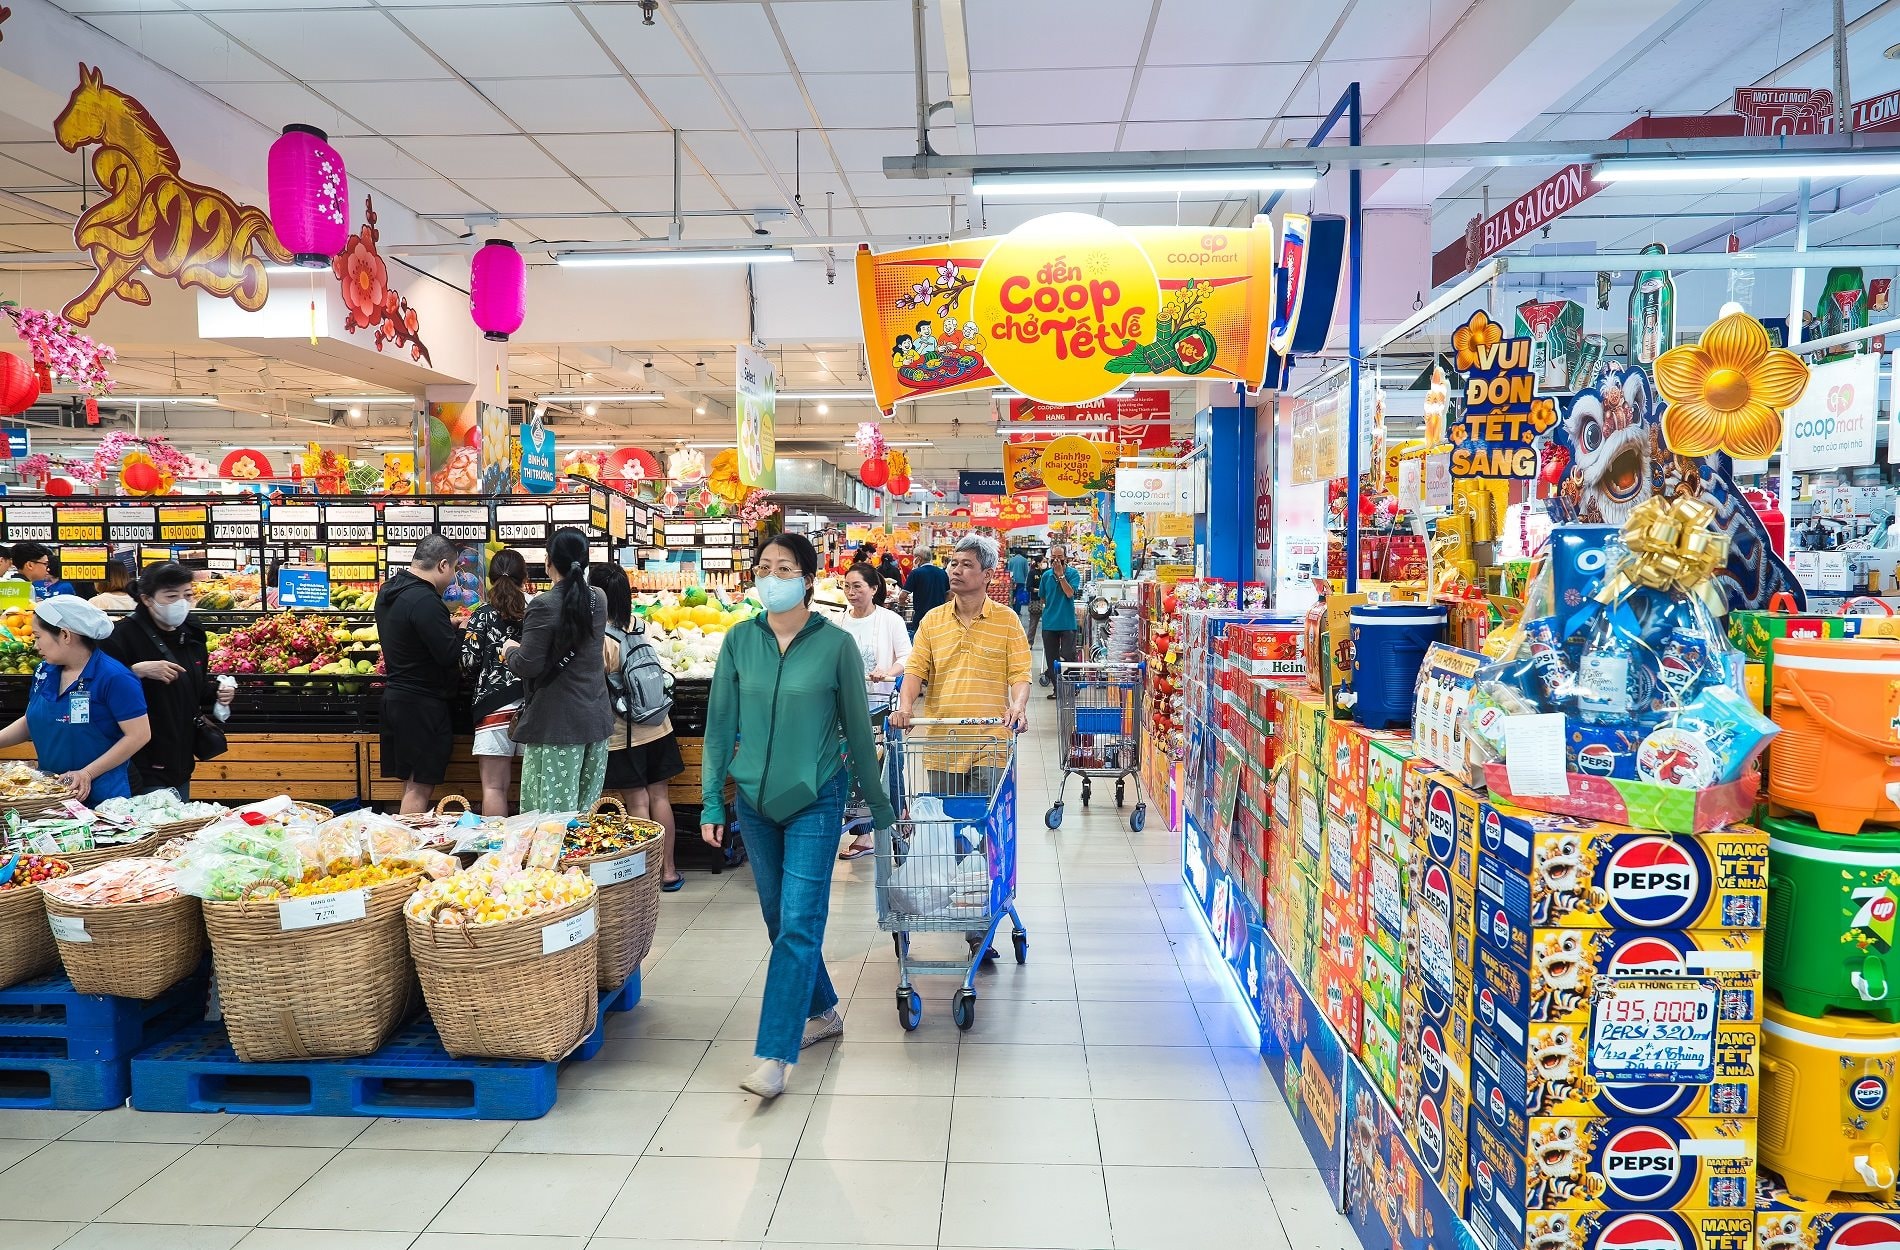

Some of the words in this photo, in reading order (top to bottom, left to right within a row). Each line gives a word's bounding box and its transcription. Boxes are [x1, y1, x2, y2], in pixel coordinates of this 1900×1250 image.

[1483, 210, 1513, 255] BIA
[1514, 167, 1582, 236] SAIGON
[77, 146, 269, 312] 2026
[1037, 255, 1082, 285] đến
[991, 313, 1040, 344] chở
[1040, 315, 1138, 361] Tết
[1180, 341, 1201, 360] Tết
[1477, 340, 1529, 371] VUI
[1466, 370, 1533, 406] ĐÓN
[1466, 405, 1528, 442] TẾT
[1045, 458, 1063, 468] Khai
[1451, 447, 1535, 477] SANG
[1258, 500, 1270, 520] GÓI
[111, 527, 146, 538] 61.500
[214, 525, 250, 537] 77.900
[500, 525, 537, 537] 53.900
[1581, 754, 1612, 769] PEPSI
[1430, 810, 1452, 838] PEPSI
[1486, 822, 1500, 838] PEPSI
[1717, 842, 1769, 857] MANG
[1721, 855, 1766, 876] TẾT
[1612, 872, 1690, 891] PEPSI
[1716, 875, 1736, 889] VỀ
[1737, 876, 1768, 889] NHÀ
[1494, 920, 1508, 938] PEPSI
[1741, 968, 1761, 979] TẾT
[1480, 999, 1494, 1018] PEPSI
[1422, 1043, 1442, 1076] PEPSI
[1725, 1064, 1755, 1077] NHÀ
[1857, 1088, 1882, 1097] PEPSI
[1491, 1099, 1505, 1116] PEPSI
[1315, 1101, 1332, 1142] SANG
[1419, 1114, 1441, 1155] PEPSI
[1609, 1156, 1674, 1171] PEPSI
[1707, 1158, 1734, 1167] MANG
[1735, 1156, 1753, 1167] TẾT
[1713, 1166, 1727, 1174] VỀ
[1727, 1166, 1746, 1174] NHÀ
[1478, 1170, 1492, 1193] PEPSI
[1702, 1218, 1752, 1233] MANG
[1706, 1232, 1748, 1250] TẾT
